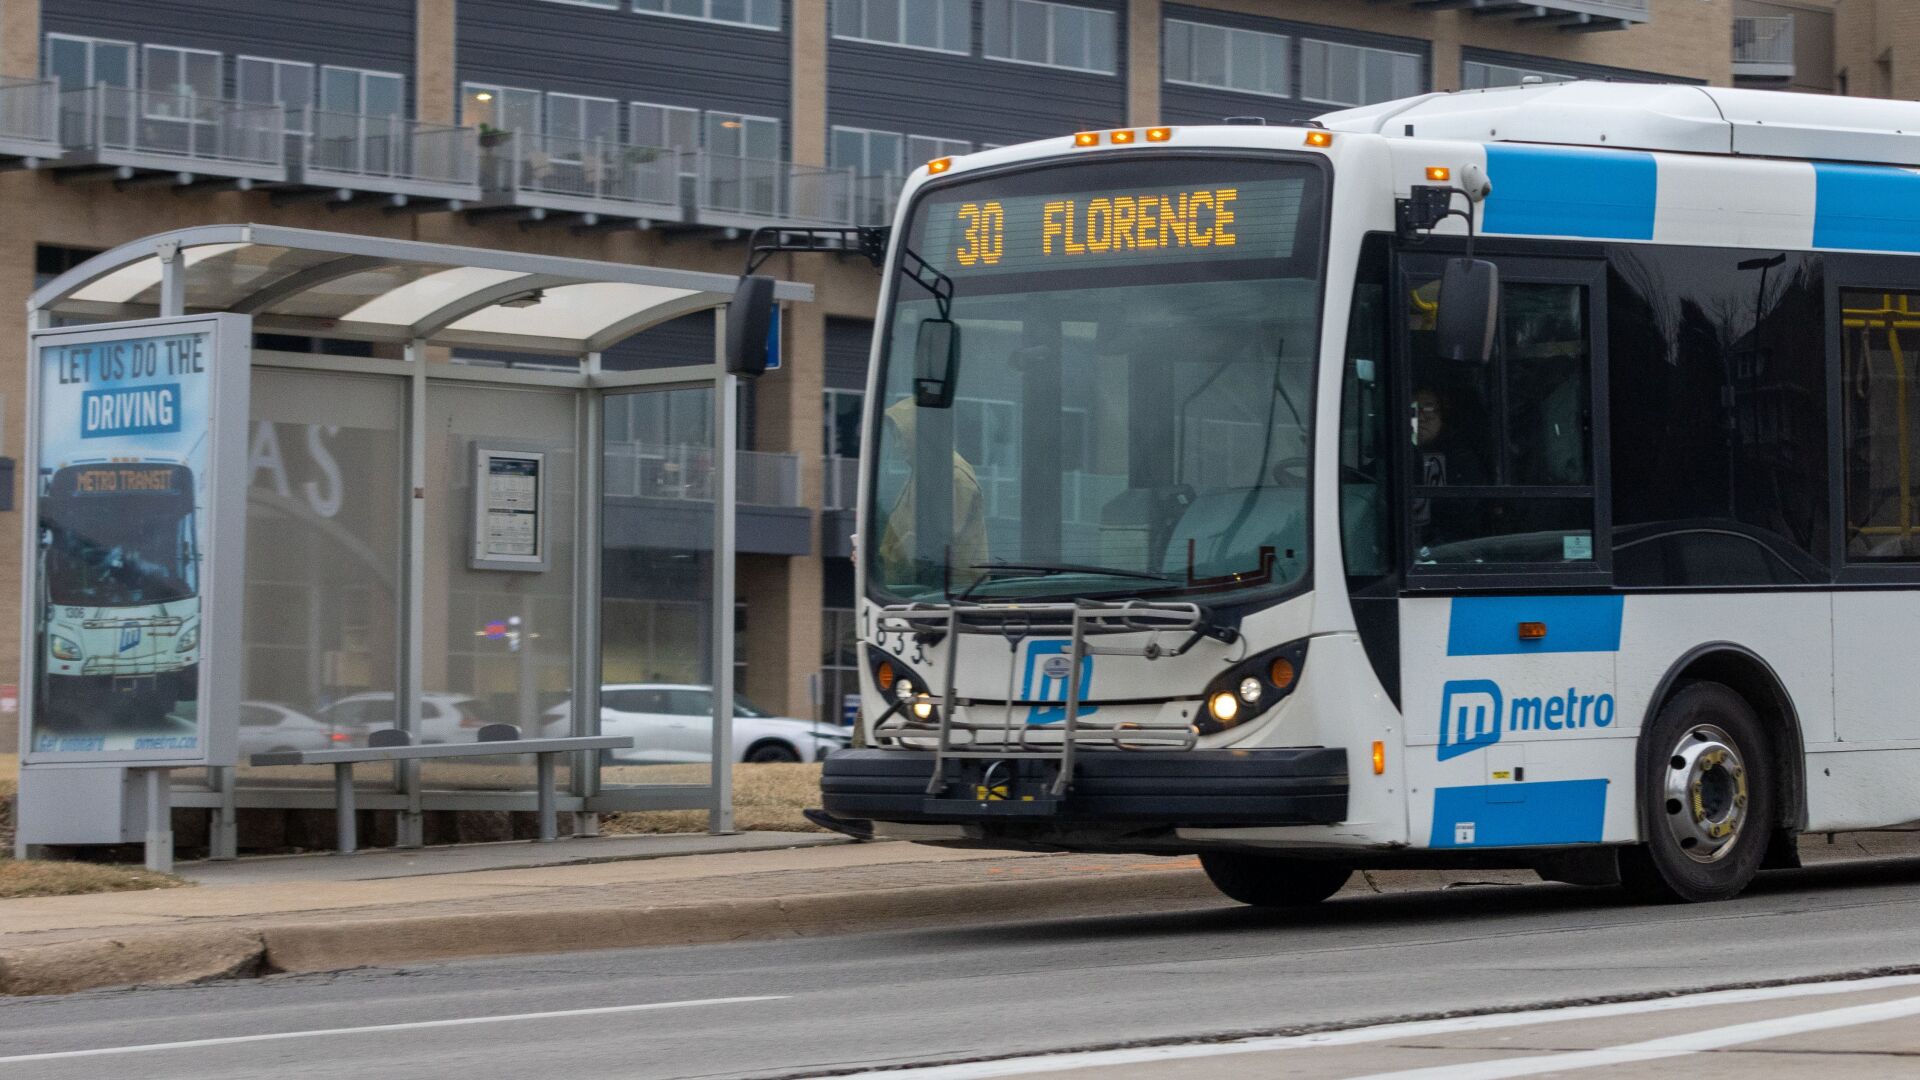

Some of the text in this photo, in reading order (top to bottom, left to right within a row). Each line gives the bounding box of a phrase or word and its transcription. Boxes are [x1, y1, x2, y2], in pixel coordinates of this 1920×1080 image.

[957, 188, 1238, 265] 30 FLORENCE
[59, 337, 204, 384] LET US DO THE
[86, 389, 174, 431] DRIVING
[77, 468, 173, 492] METRO TRANSIT
[1510, 687, 1615, 731] metro
